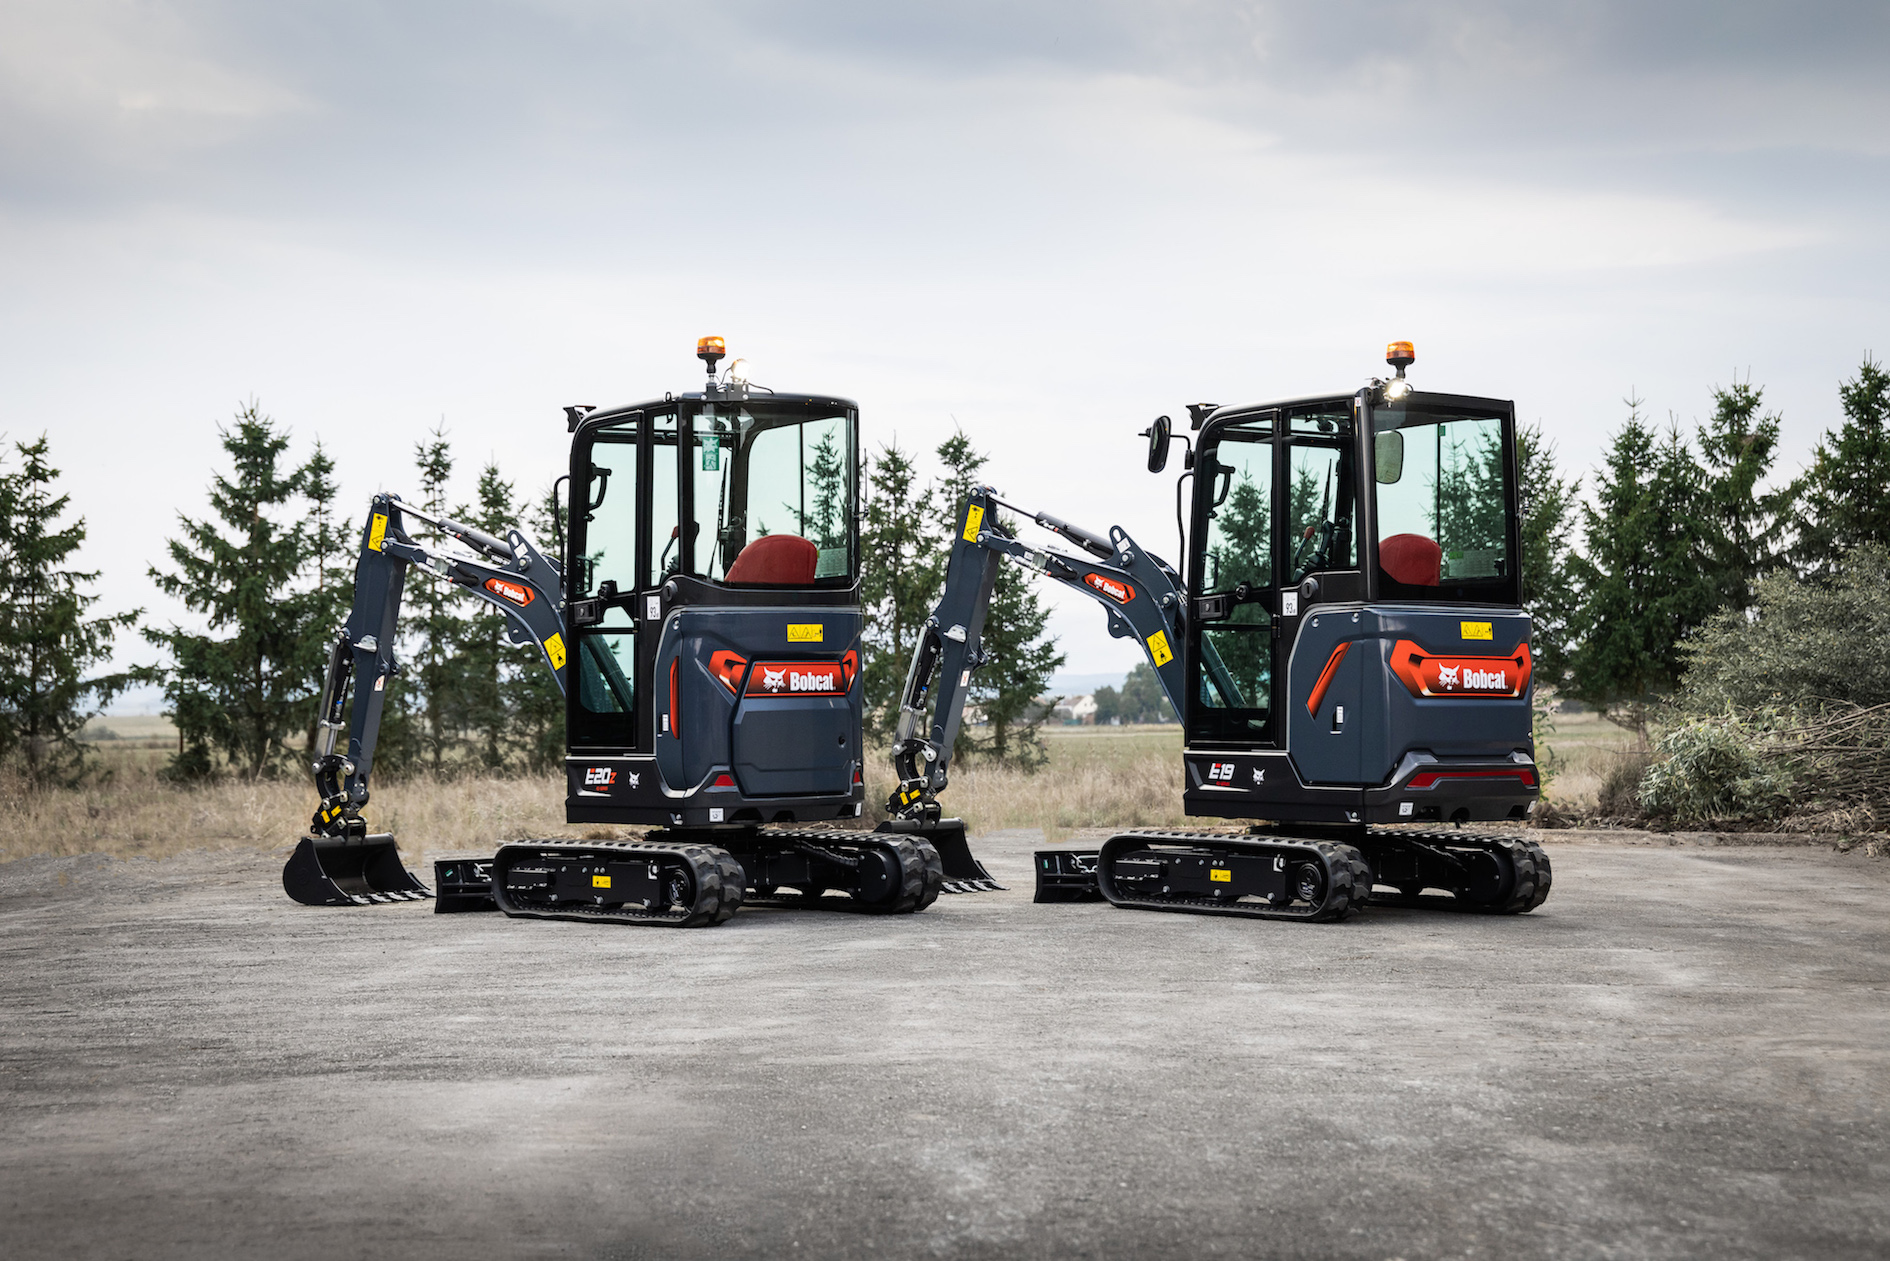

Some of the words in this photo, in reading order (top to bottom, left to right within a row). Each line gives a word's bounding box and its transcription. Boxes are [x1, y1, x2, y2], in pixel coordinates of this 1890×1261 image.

[504, 586, 525, 602] Bobcat
[1103, 583, 1125, 599] Bobcat
[790, 672, 834, 691] Bobcat
[1463, 669, 1506, 690] Bobcat
[1208, 763, 1235, 780] E19
